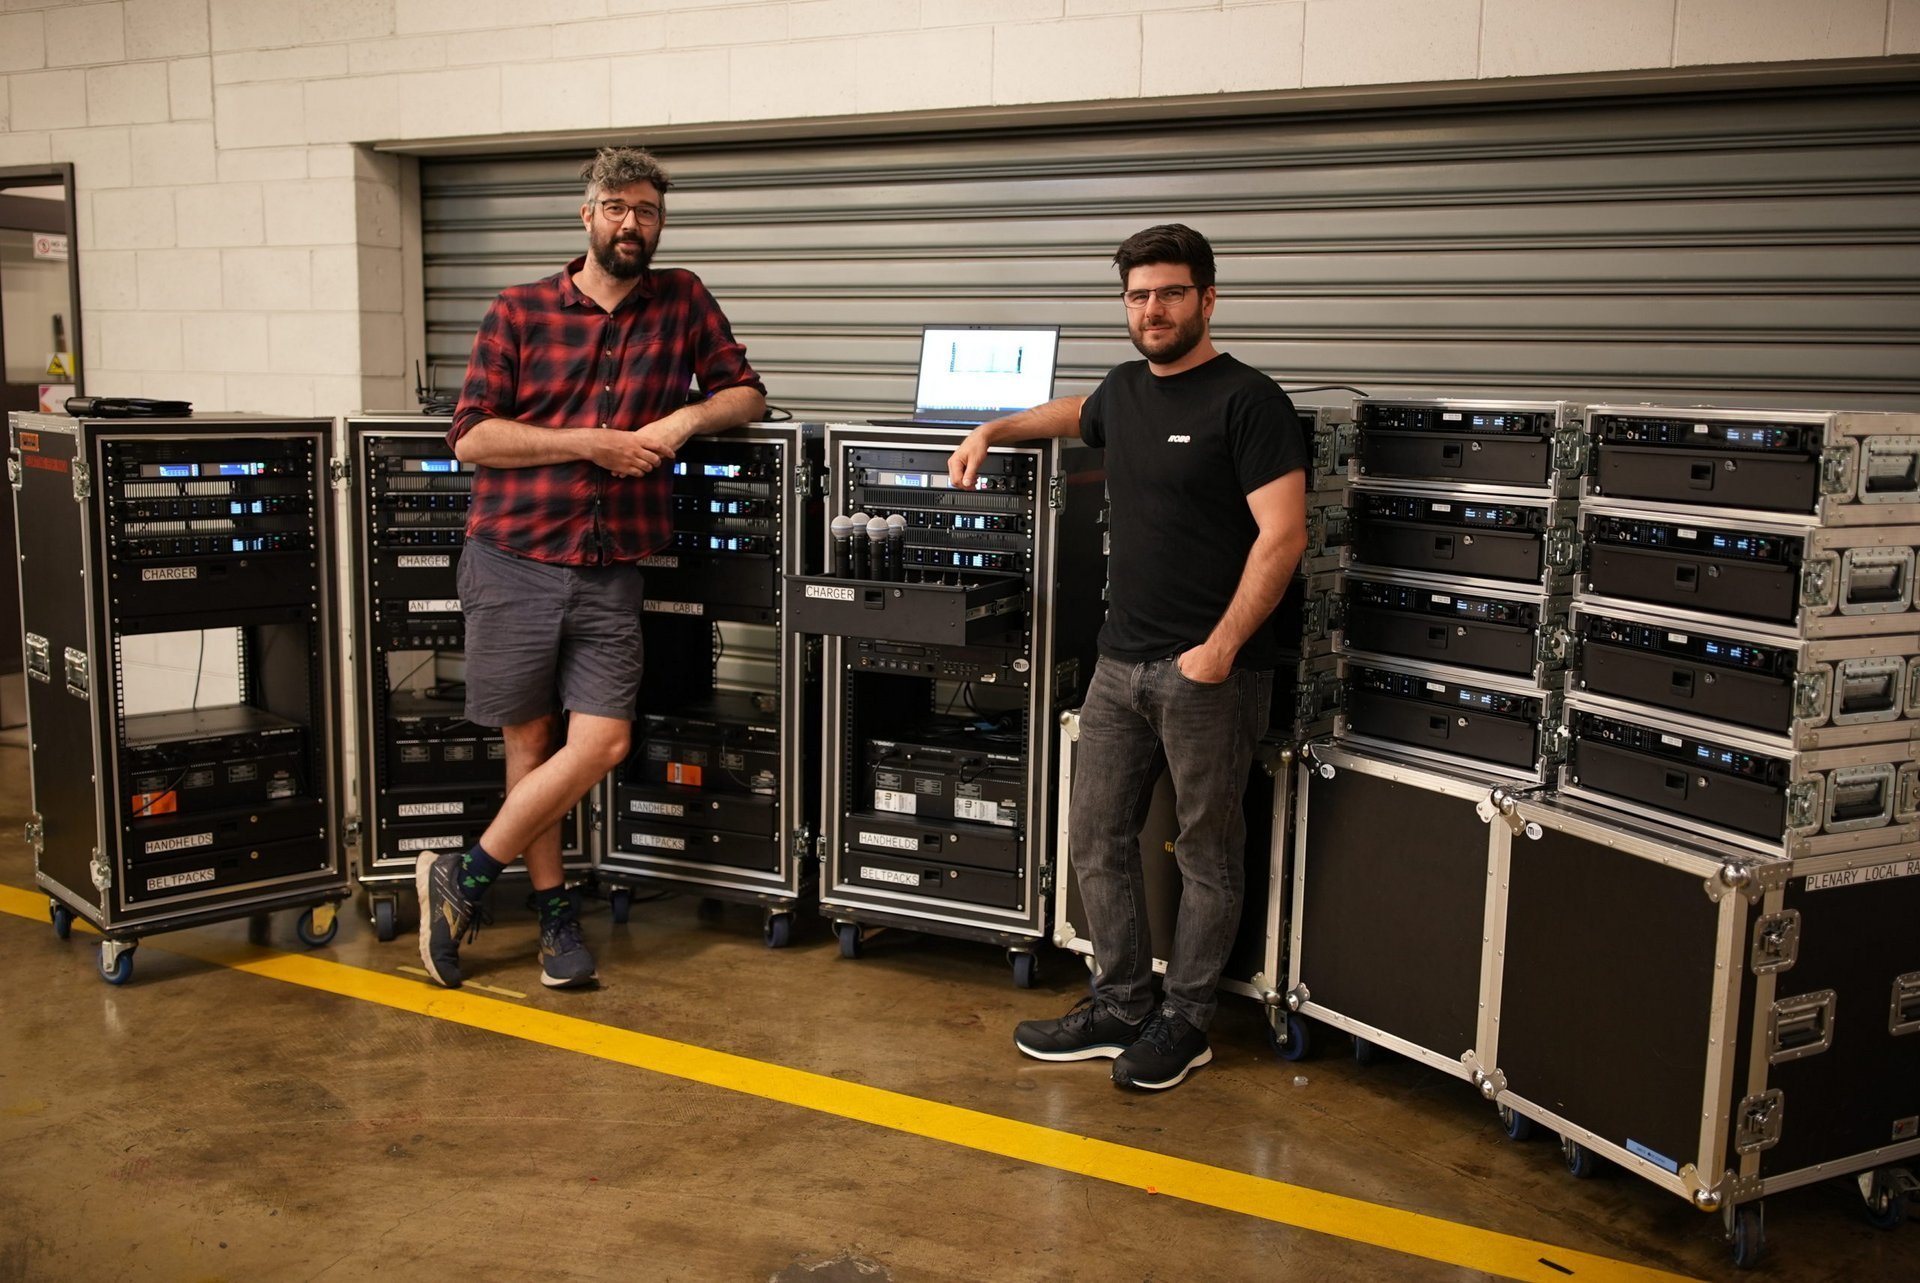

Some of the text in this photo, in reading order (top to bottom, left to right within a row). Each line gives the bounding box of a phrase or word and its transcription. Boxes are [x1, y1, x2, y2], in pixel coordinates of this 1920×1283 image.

[400, 555, 449, 567] CHARGER
[639, 555, 678, 567] HARGER
[143, 567, 197, 580] CHARGER
[806, 585, 854, 600] CHARGER
[444, 600, 460, 611] CA
[672, 602, 703, 615] CABLE
[400, 802, 463, 815] HANDHELDS
[631, 801, 683, 816] HANDHELDS
[146, 832, 213, 853] HANDHELDS
[400, 835, 463, 850] BELTPACKS
[632, 834, 684, 850] BELTPACKS
[860, 832, 918, 850] HANDHELDS
[148, 868, 214, 889] BELTPACKS
[862, 867, 919, 886] BELTPACKS
[1806, 869, 1859, 890] PLENARY
[1865, 863, 1900, 881] LOCAL
